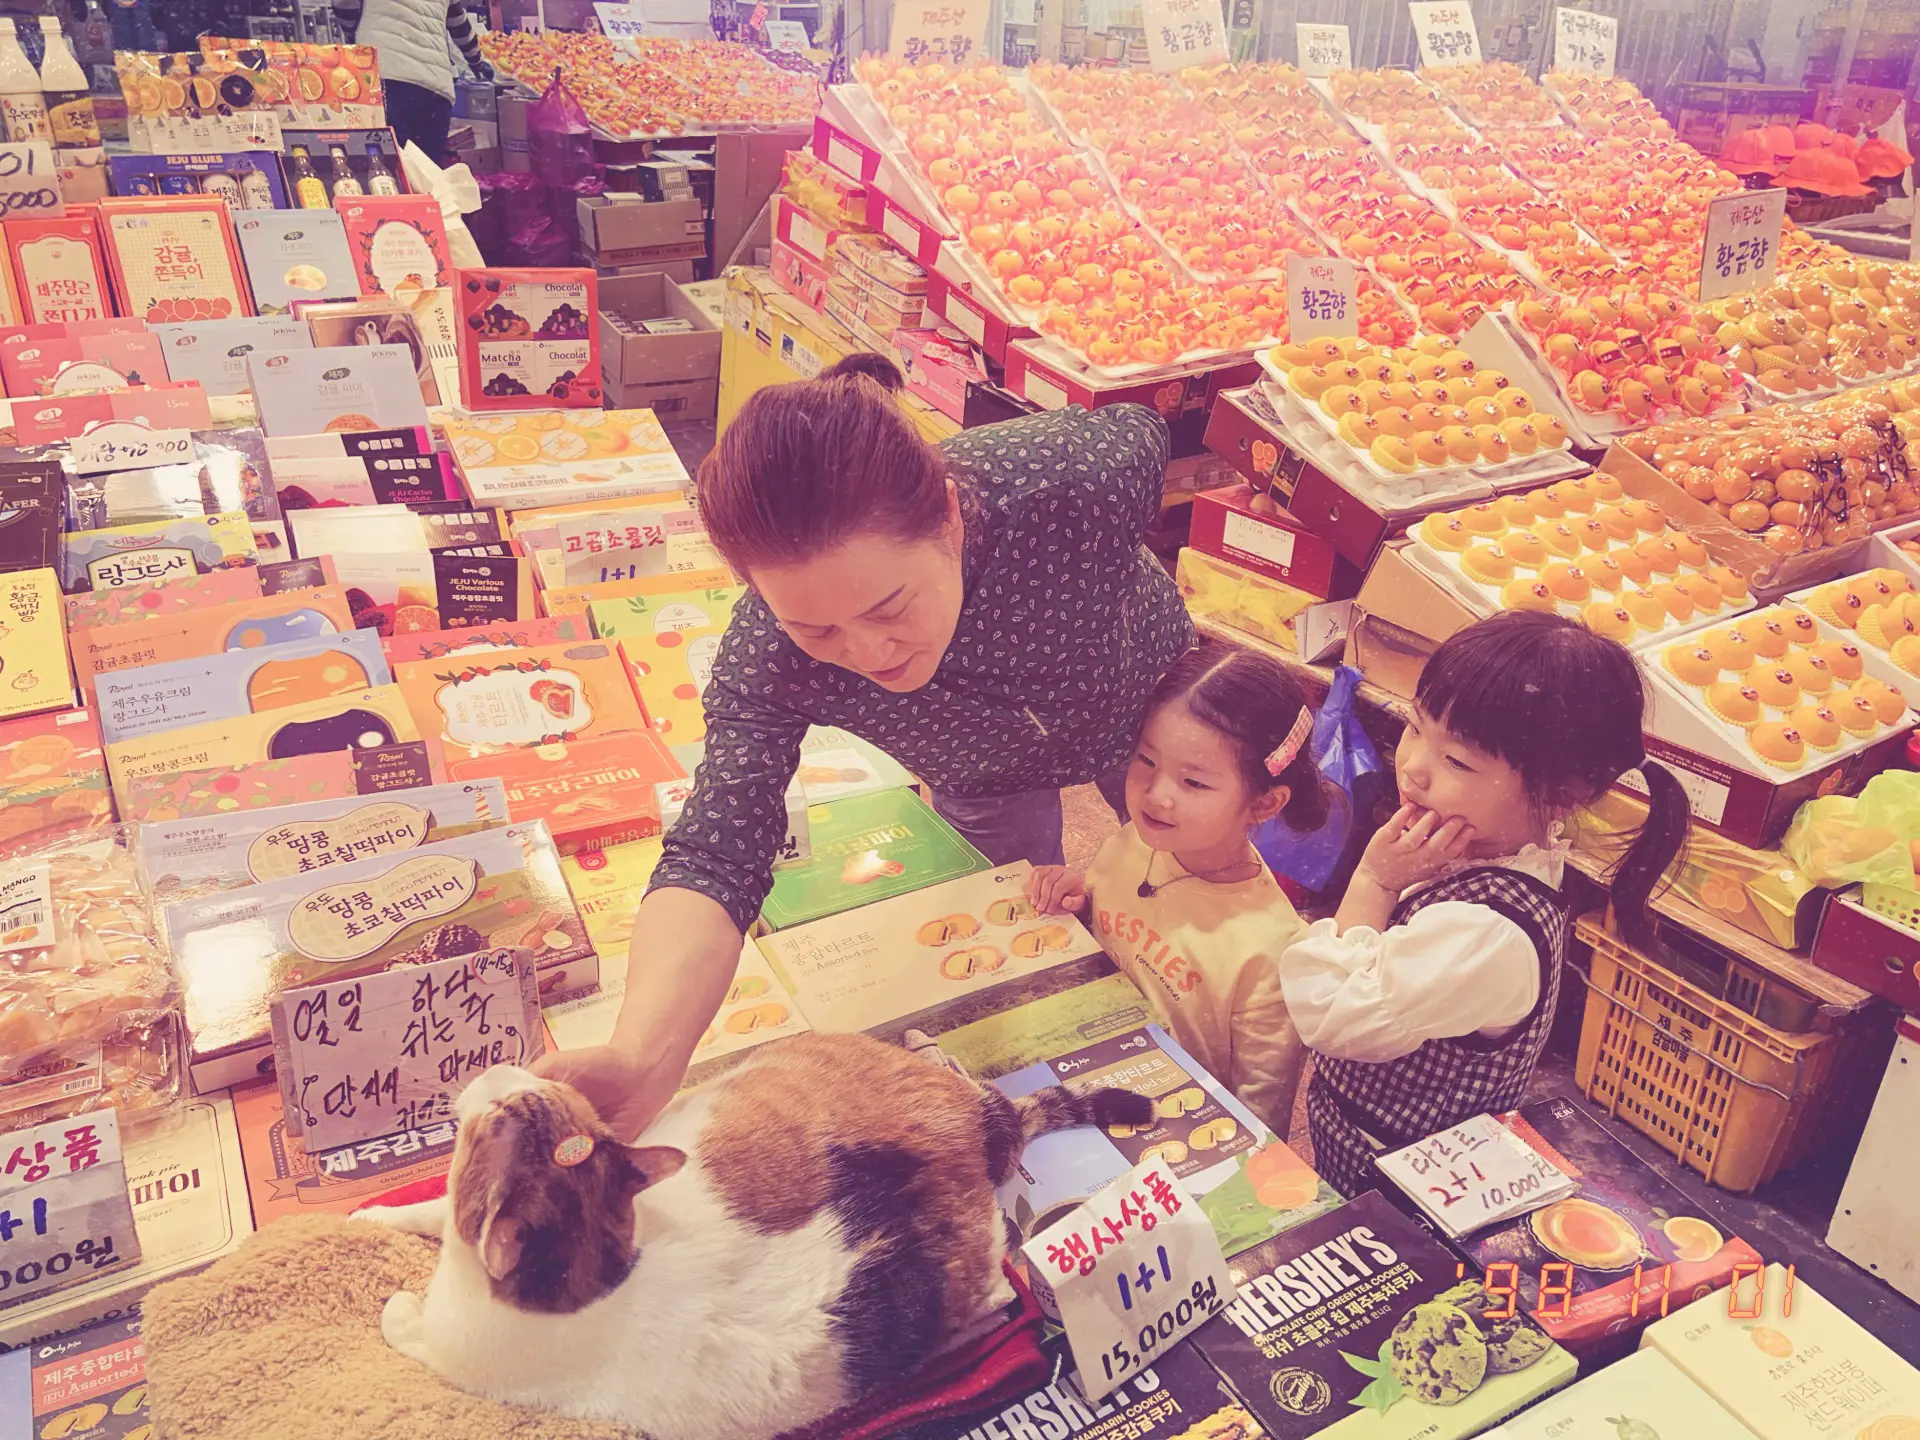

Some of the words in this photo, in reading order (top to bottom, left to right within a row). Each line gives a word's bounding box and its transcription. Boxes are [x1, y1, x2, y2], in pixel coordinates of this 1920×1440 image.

[922, 9, 967, 26] 제주산
[1430, 10, 1459, 25] 제주산
[1162, 21, 1212, 52] 황금향
[1428, 30, 1472, 58] 황금향
[1568, 43, 1606, 70] 가능
[167, 157, 189, 165] JEJU
[192, 157, 224, 165] BLUES
[1716, 236, 1769, 278] 황금향
[154, 263, 204, 282] 쫀득이
[36, 279, 92, 297] 제주당근
[545, 283, 583, 292] Chocolat
[1301, 286, 1346, 320] 황금향
[481, 352, 522, 363] Matcha
[549, 351, 587, 360] Chocolat
[407, 489, 433, 497] Cactus
[98, 556, 188, 586] 랑그드샤
[472, 578, 505, 586] Various
[600, 564, 636, 583] 1+1
[18, 609, 39, 622] 빵
[108, 684, 133, 694] Royal
[111, 686, 191, 709] 제주우유크림
[112, 703, 169, 723] 랑그드샤
[124, 751, 209, 778] 우도땅콩크림
[377, 752, 404, 762] Royal
[266, 828, 297, 847] 우도
[286, 830, 330, 855] 땅콩
[299, 824, 415, 873] 초코찰떡파이
[304, 892, 336, 914] 우도
[328, 890, 374, 920] 땅콩
[343, 875, 464, 940] 초코찰떡파이
[781, 934, 817, 953] 제주
[1099, 910, 1202, 993] BESTIES
[816, 950, 861, 971] Assorted
[1657, 1012, 1693, 1042] 제주
[1554, 1107, 1576, 1120] JEJU
[380, 1169, 415, 1185] Original
[1428, 1161, 1487, 1208] 2+1
[1046, 1171, 1182, 1277] 행사상품
[1116, 1244, 1173, 1311] 1+1
[1223, 1225, 1399, 1338] HERSHEY'S
[1253, 1315, 1307, 1348] CHOCOLATE
[1304, 1304, 1328, 1323] CHIP
[1327, 1293, 1354, 1312] GREEN
[1353, 1283, 1373, 1301] TEA
[1371, 1261, 1410, 1288] COOKIES
[1261, 1339, 1295, 1360] 허쉬
[1291, 1317, 1336, 1348] 초콜릿
[1330, 1309, 1351, 1328] 칩
[1344, 1270, 1424, 1316] 제주녹차쿠키
[1101, 1274, 1225, 1381] 15,000원
[38, 1345, 67, 1359] Only
[68, 1362, 140, 1397] Assorted
[1781, 1358, 1865, 1412] 제주한라봉
[1125, 1388, 1171, 1417] COOKIES
